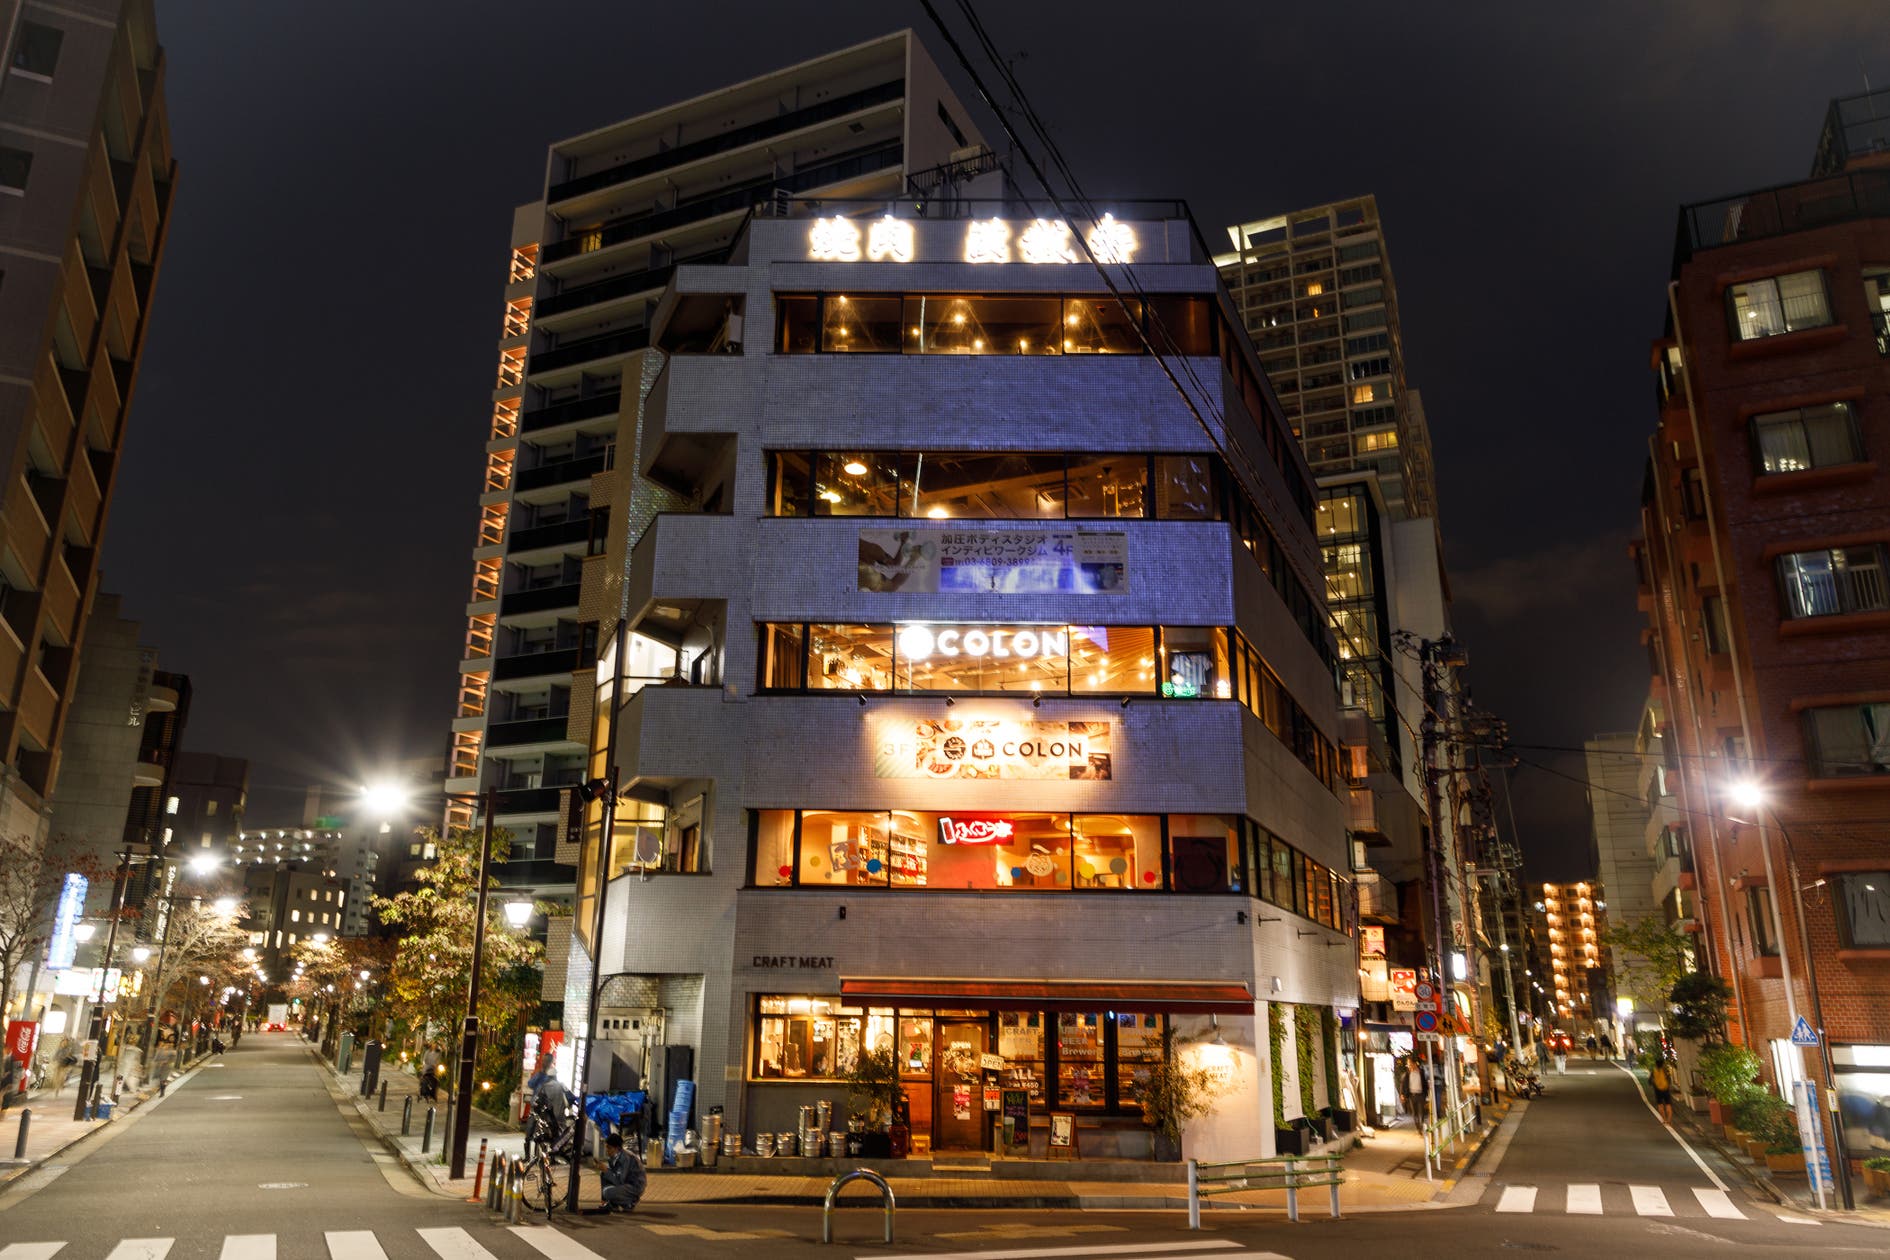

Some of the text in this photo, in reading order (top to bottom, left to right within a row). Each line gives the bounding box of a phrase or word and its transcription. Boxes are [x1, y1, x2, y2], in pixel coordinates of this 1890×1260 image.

[1052, 539, 1073, 556] 4F
[937, 630, 1068, 658] COLON
[883, 742, 1082, 758] 3F COLON
[165, 864, 177, 898] HOTEL
[753, 956, 835, 969] CRAFT MEAT
[1418, 986, 1432, 996] 30
[951, 1041, 971, 1049] OPEN
[1062, 1037, 1088, 1045] BEER
[1008, 1068, 1036, 1080] ALL
